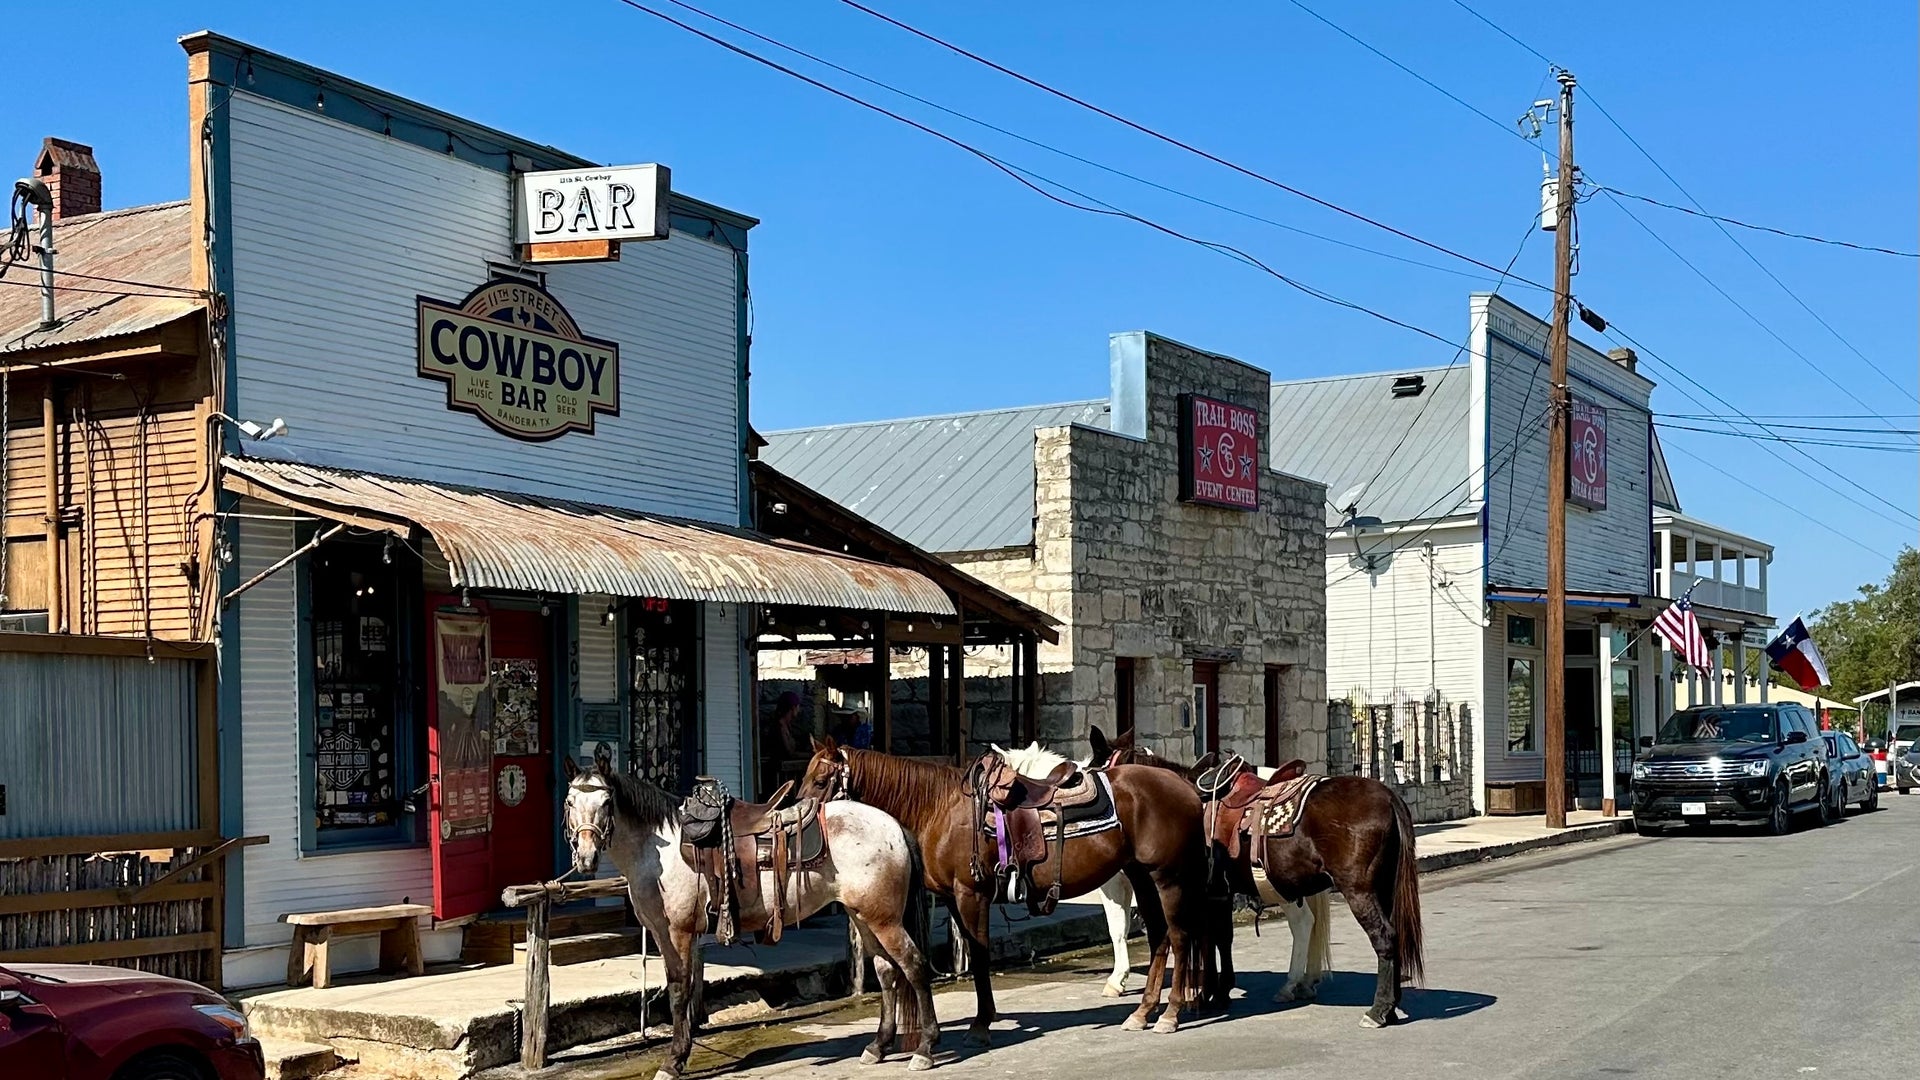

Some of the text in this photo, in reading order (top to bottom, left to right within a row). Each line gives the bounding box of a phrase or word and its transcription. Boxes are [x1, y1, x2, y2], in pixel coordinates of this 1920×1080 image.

[585, 174, 612, 182] Cowboy
[534, 183, 635, 235] BAR
[487, 288, 559, 322] 11TH STREET
[430, 319, 608, 396] COWBOY
[467, 387, 493, 401] MUSIC
[470, 377, 490, 389] LIVE
[501, 381, 547, 413] BAR
[556, 394, 578, 406] COLD
[556, 405, 577, 417] BEER
[497, 408, 551, 428] BANDERA TX
[1195, 400, 1256, 440] TRAIL BOSS
[1196, 479, 1257, 505] EVENT CENTER
[661, 550, 774, 590] BAR
[570, 640, 579, 698] 307
